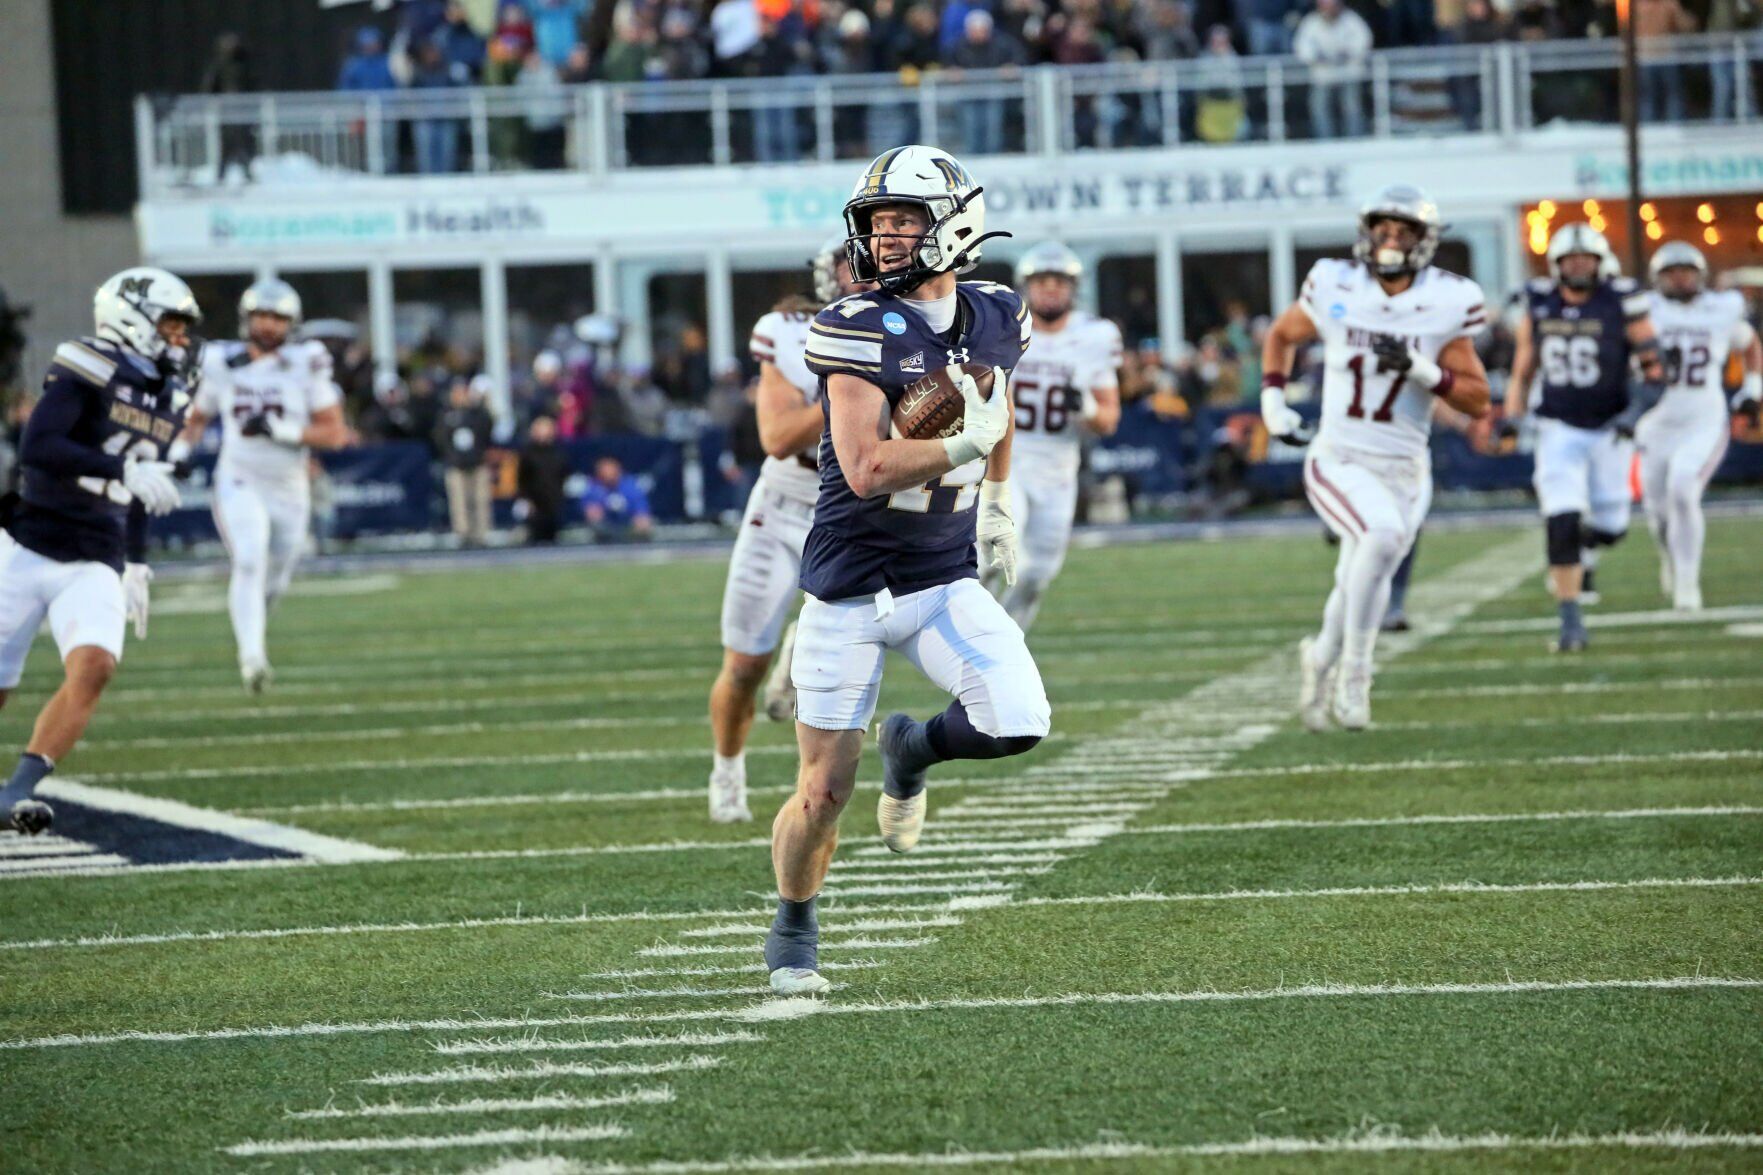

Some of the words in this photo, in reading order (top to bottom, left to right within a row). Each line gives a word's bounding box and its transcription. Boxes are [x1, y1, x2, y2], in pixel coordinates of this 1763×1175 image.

[1124, 166, 1347, 205] TERRACE
[407, 201, 546, 234] Health
[910, 354, 923, 366] SKY
[1346, 352, 1408, 422] 17
